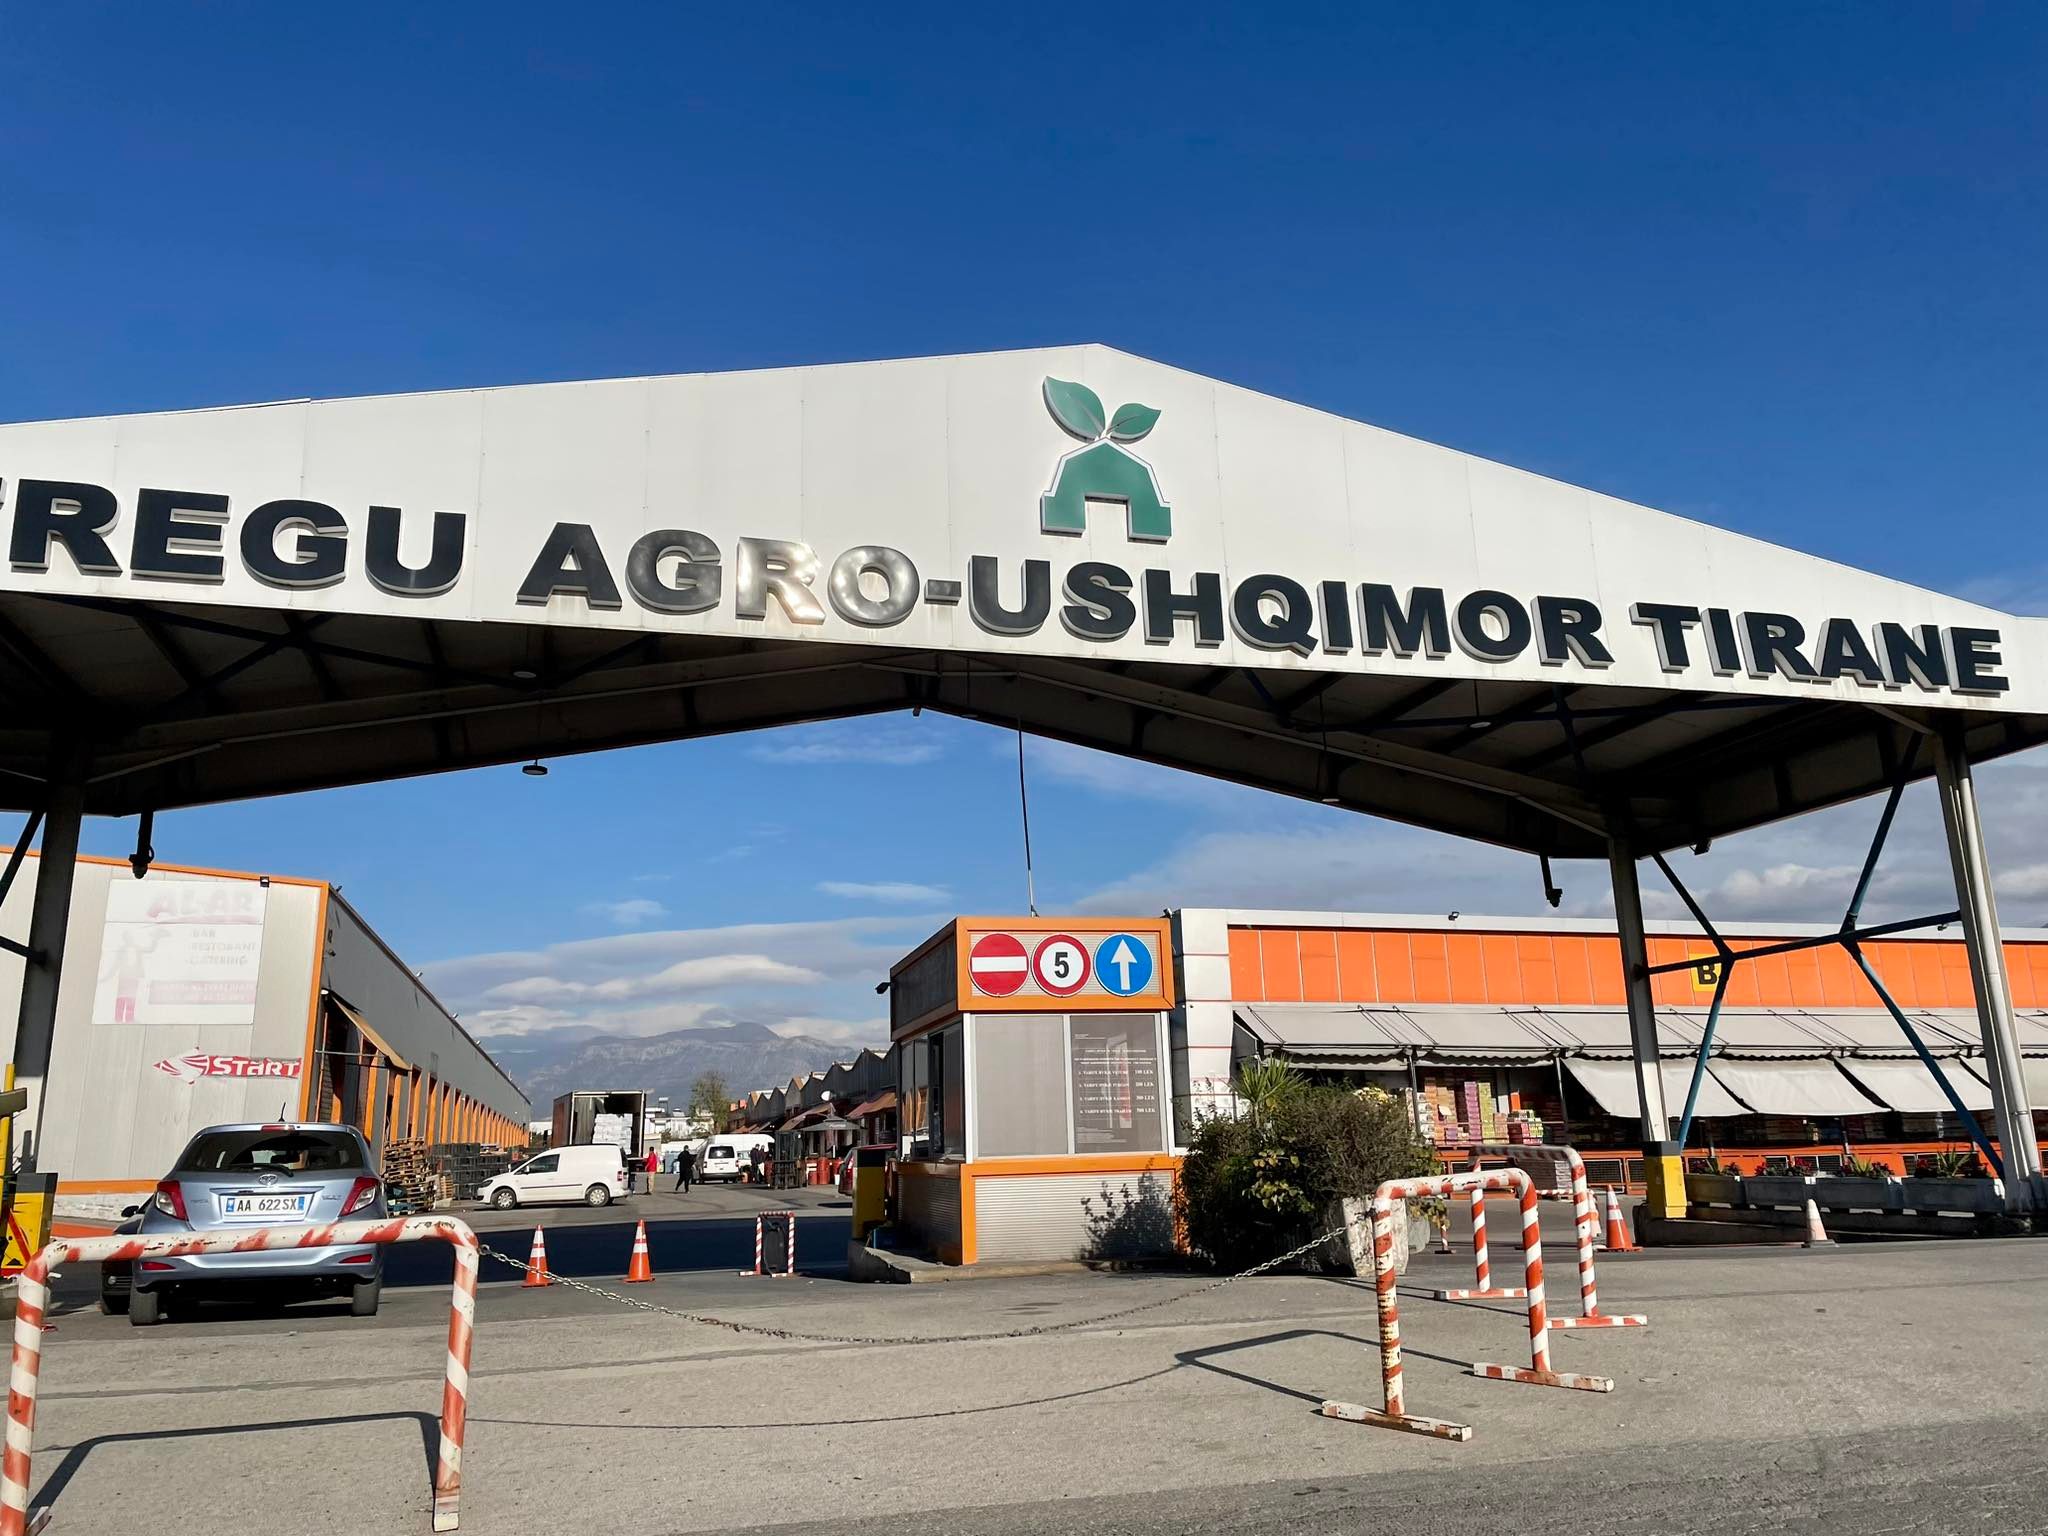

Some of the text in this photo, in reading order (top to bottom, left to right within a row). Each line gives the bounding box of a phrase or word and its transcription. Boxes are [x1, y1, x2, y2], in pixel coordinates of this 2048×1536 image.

[0, 477, 2010, 697] REGU AGRO-USHQIMOR TIRANE
[1054, 951, 1070, 979] 5
[1696, 963, 1718, 985] B
[237, 1199, 251, 1212] AA
